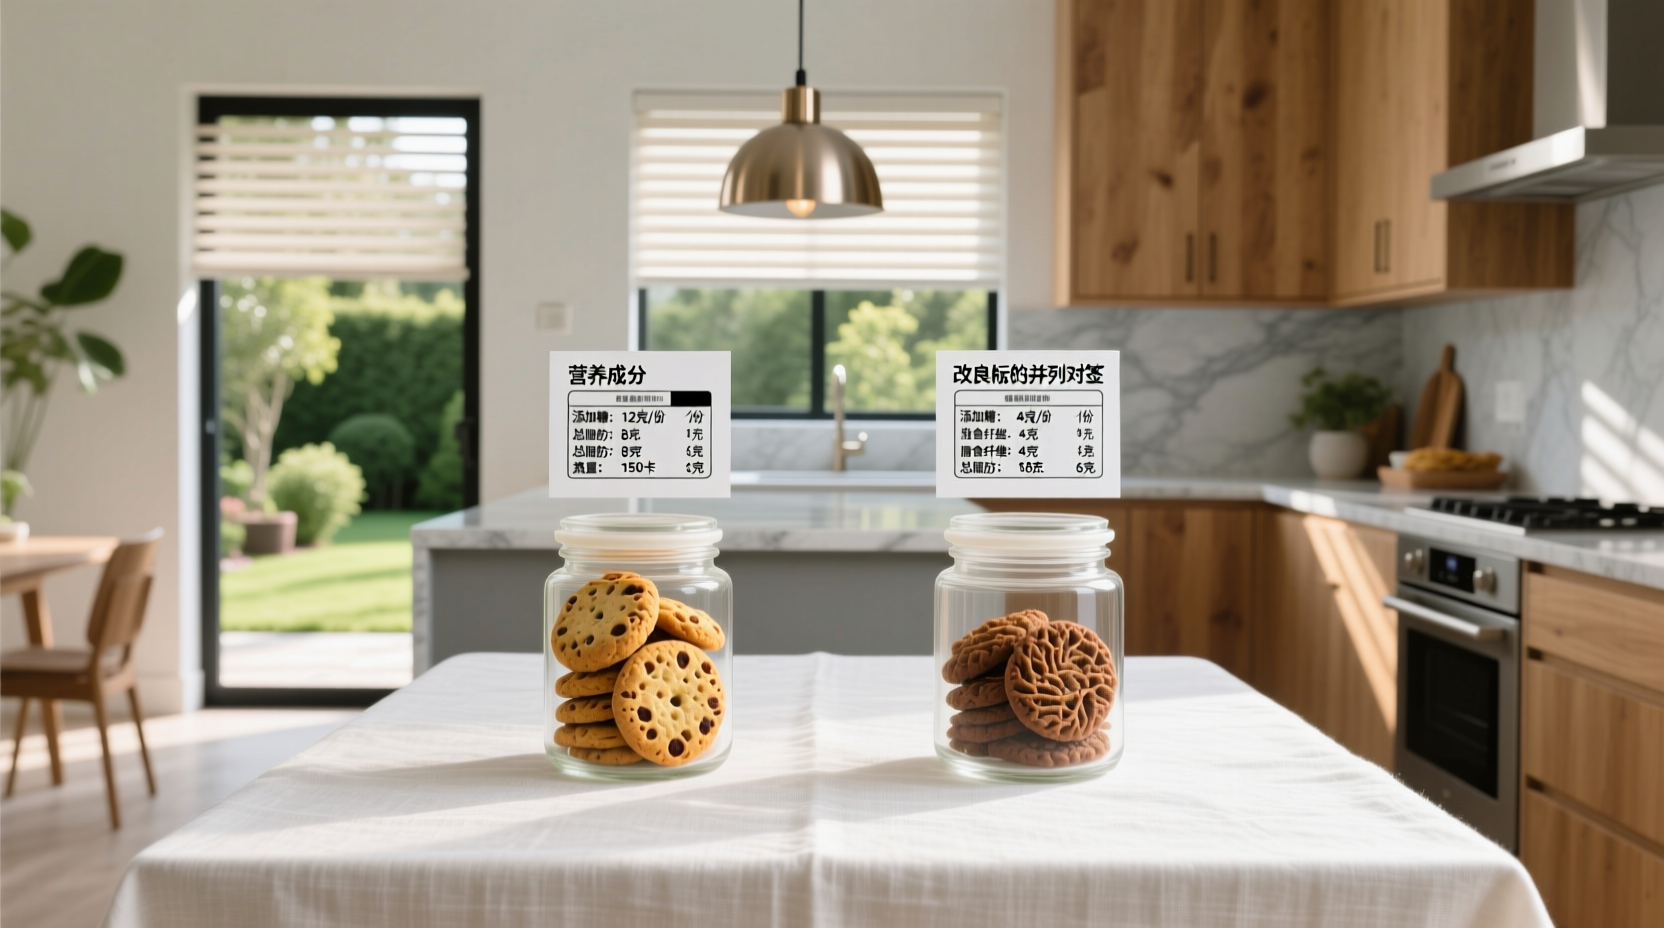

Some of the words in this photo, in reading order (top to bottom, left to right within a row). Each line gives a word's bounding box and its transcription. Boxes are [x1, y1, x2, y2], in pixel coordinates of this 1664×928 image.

[568, 363, 647, 387] 营养成分
[1018, 427, 1039, 441] 4克
[621, 445, 643, 458] 8克
[1017, 445, 1039, 458] 4克
[620, 460, 656, 475] 150卡
[1075, 461, 1096, 475] 6克
